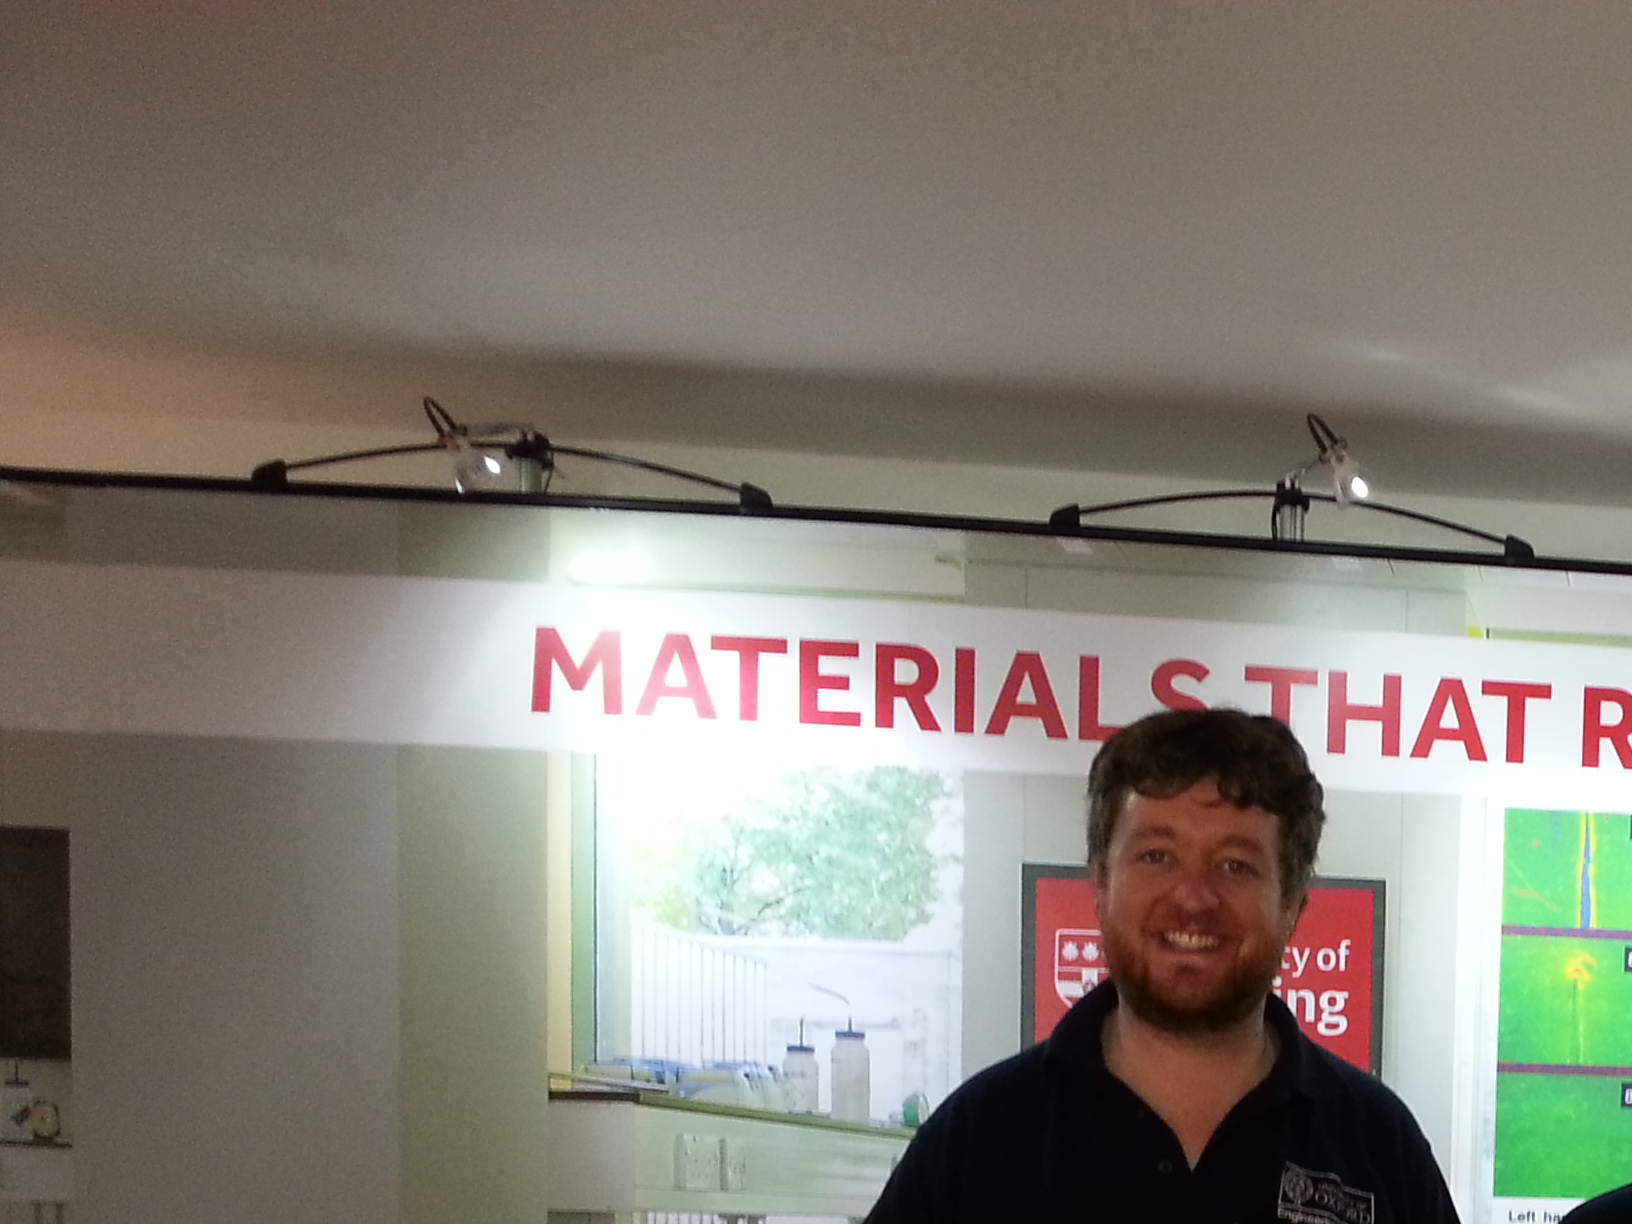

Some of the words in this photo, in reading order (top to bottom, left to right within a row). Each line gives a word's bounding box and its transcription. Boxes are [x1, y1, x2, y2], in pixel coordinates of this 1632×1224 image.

[530, 626, 1213, 742] MATERIALS
[1244, 665, 1553, 765] THAT
[1316, 938, 1352, 972] of
[1508, 1209, 1536, 1223] Left
